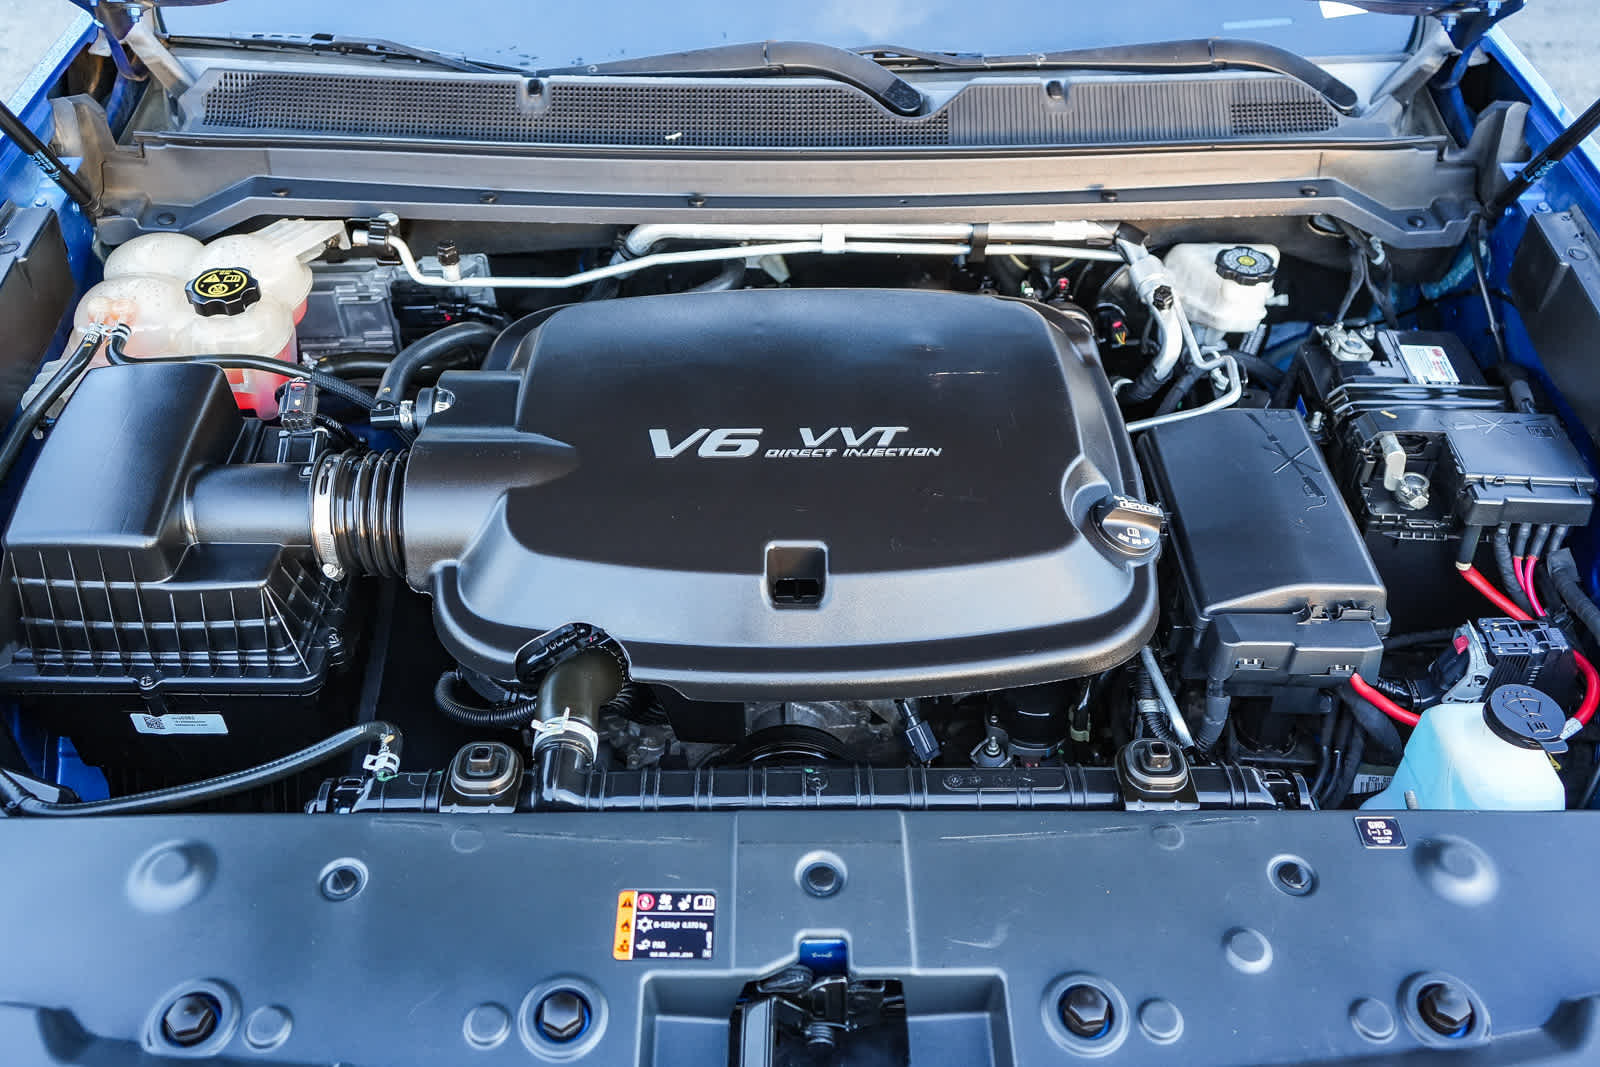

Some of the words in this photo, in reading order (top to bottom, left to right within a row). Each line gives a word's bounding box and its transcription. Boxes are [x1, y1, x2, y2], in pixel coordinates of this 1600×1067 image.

[649, 428, 764, 459] V6
[799, 426, 909, 448] VVT
[764, 448, 838, 458] DIRECT
[842, 447, 943, 457] INJECTION
